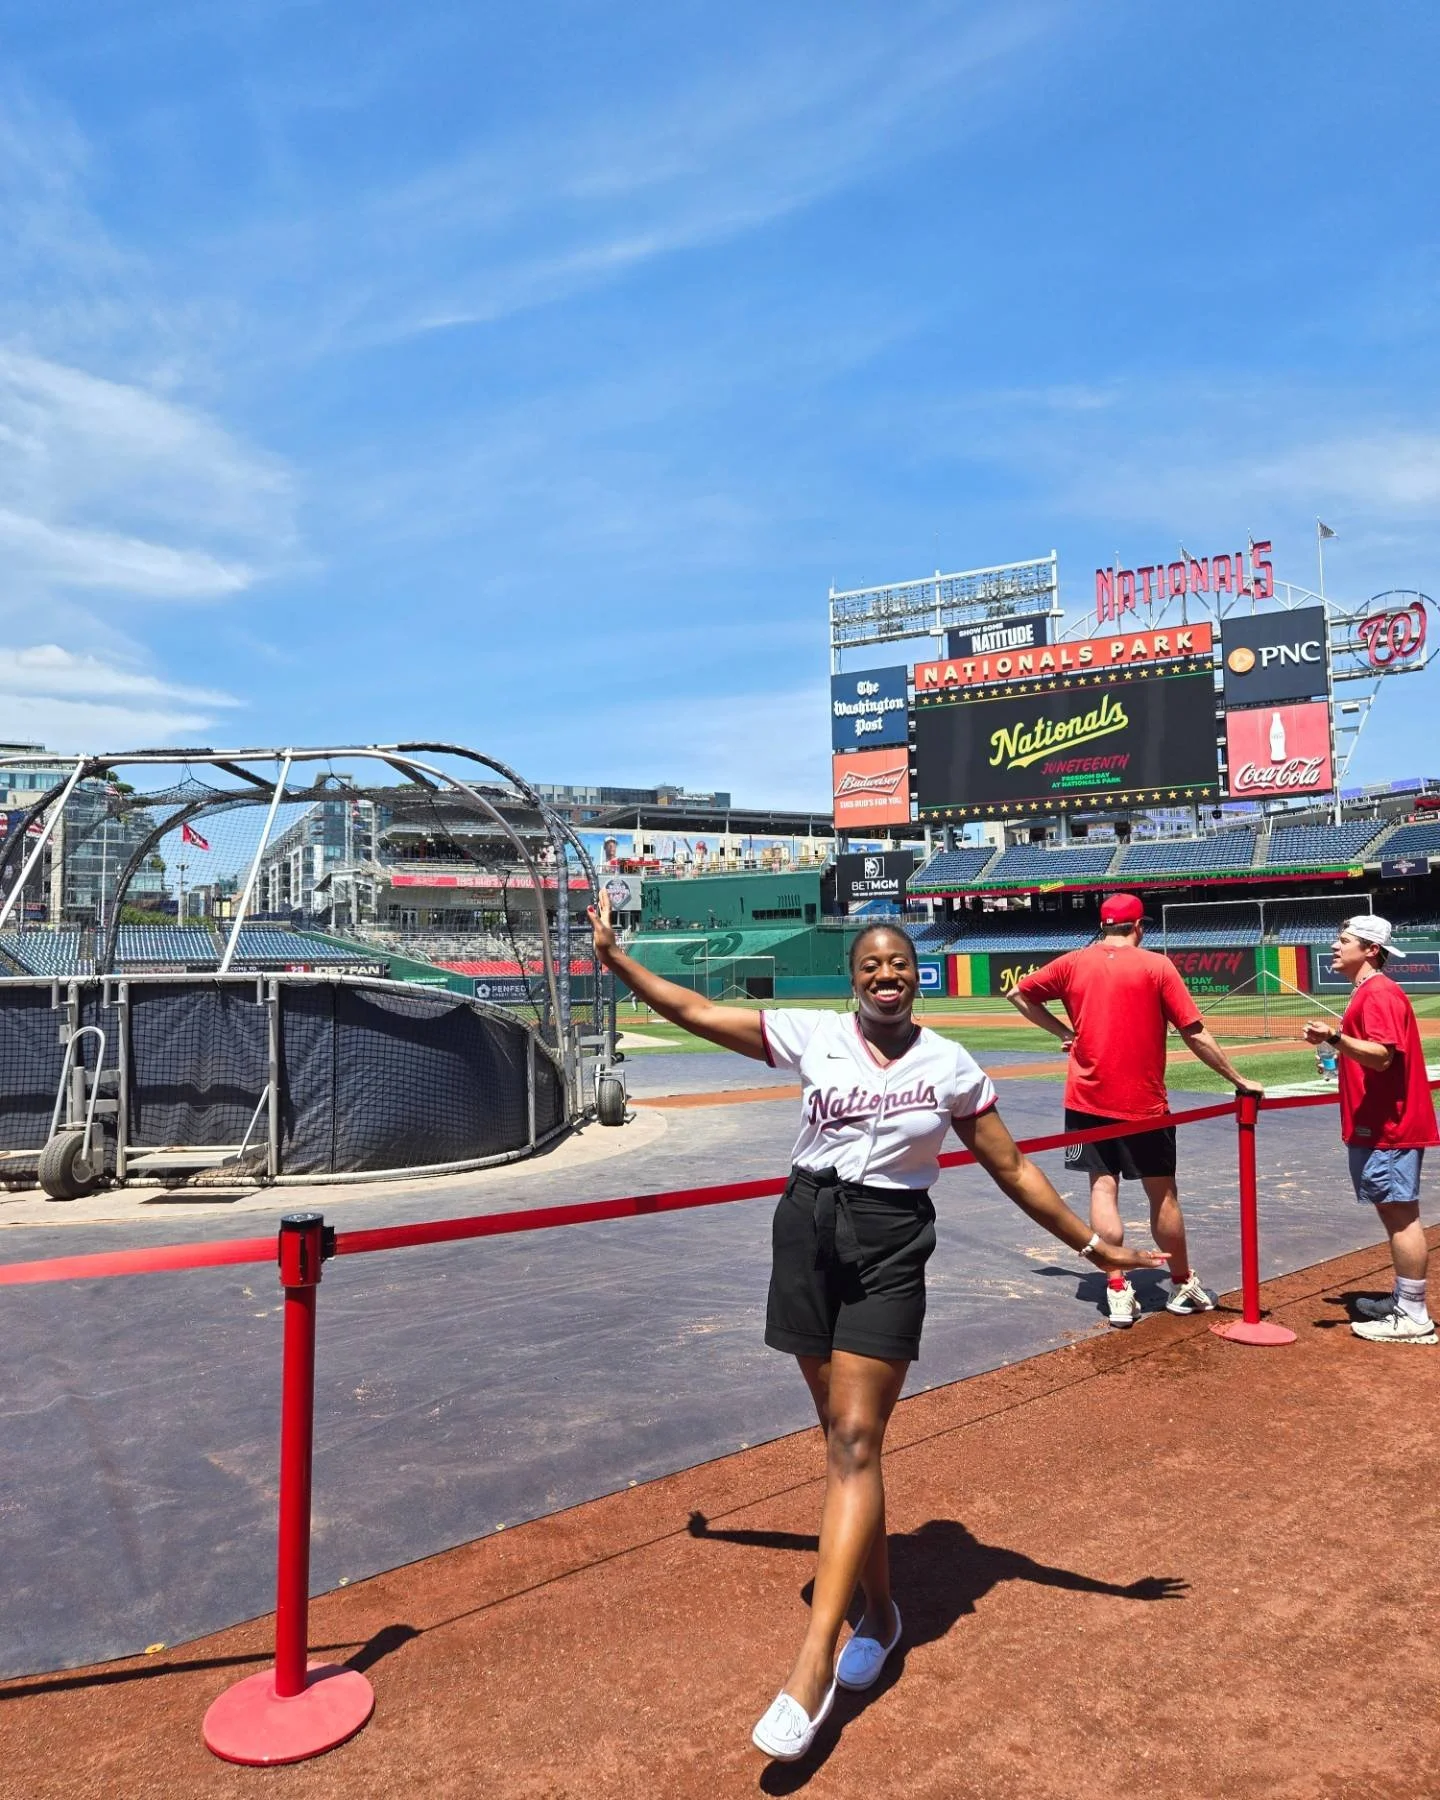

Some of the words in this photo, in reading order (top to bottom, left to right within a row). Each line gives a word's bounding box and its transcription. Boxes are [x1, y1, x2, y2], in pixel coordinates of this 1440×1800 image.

[1096, 541, 1274, 622] NATIONALS
[959, 628, 981, 638] SHOW
[982, 622, 1004, 634] SOME
[971, 623, 1035, 653] NATITUDE
[923, 646, 1094, 685] NATIONALS
[1111, 631, 1194, 659] PARK
[1258, 640, 1321, 667] PNC
[857, 680, 880, 696] The
[834, 696, 905, 717] Washington
[855, 717, 883, 737] Post
[989, 693, 1129, 770] Nationals
[1041, 752, 1130, 775] JUNETEENTH
[844, 775, 900, 791] Budweiser
[1061, 773, 1095, 782] FREEDOM
[1061, 779, 1101, 788] NATIONALS
[1101, 777, 1121, 785] PARK
[851, 879, 899, 891] BETMGM
[350, 965, 381, 975] FAN
[1191, 976, 1213, 985] DAY
[1201, 984, 1230, 993] PARK
[807, 1079, 938, 1133] Nationals
